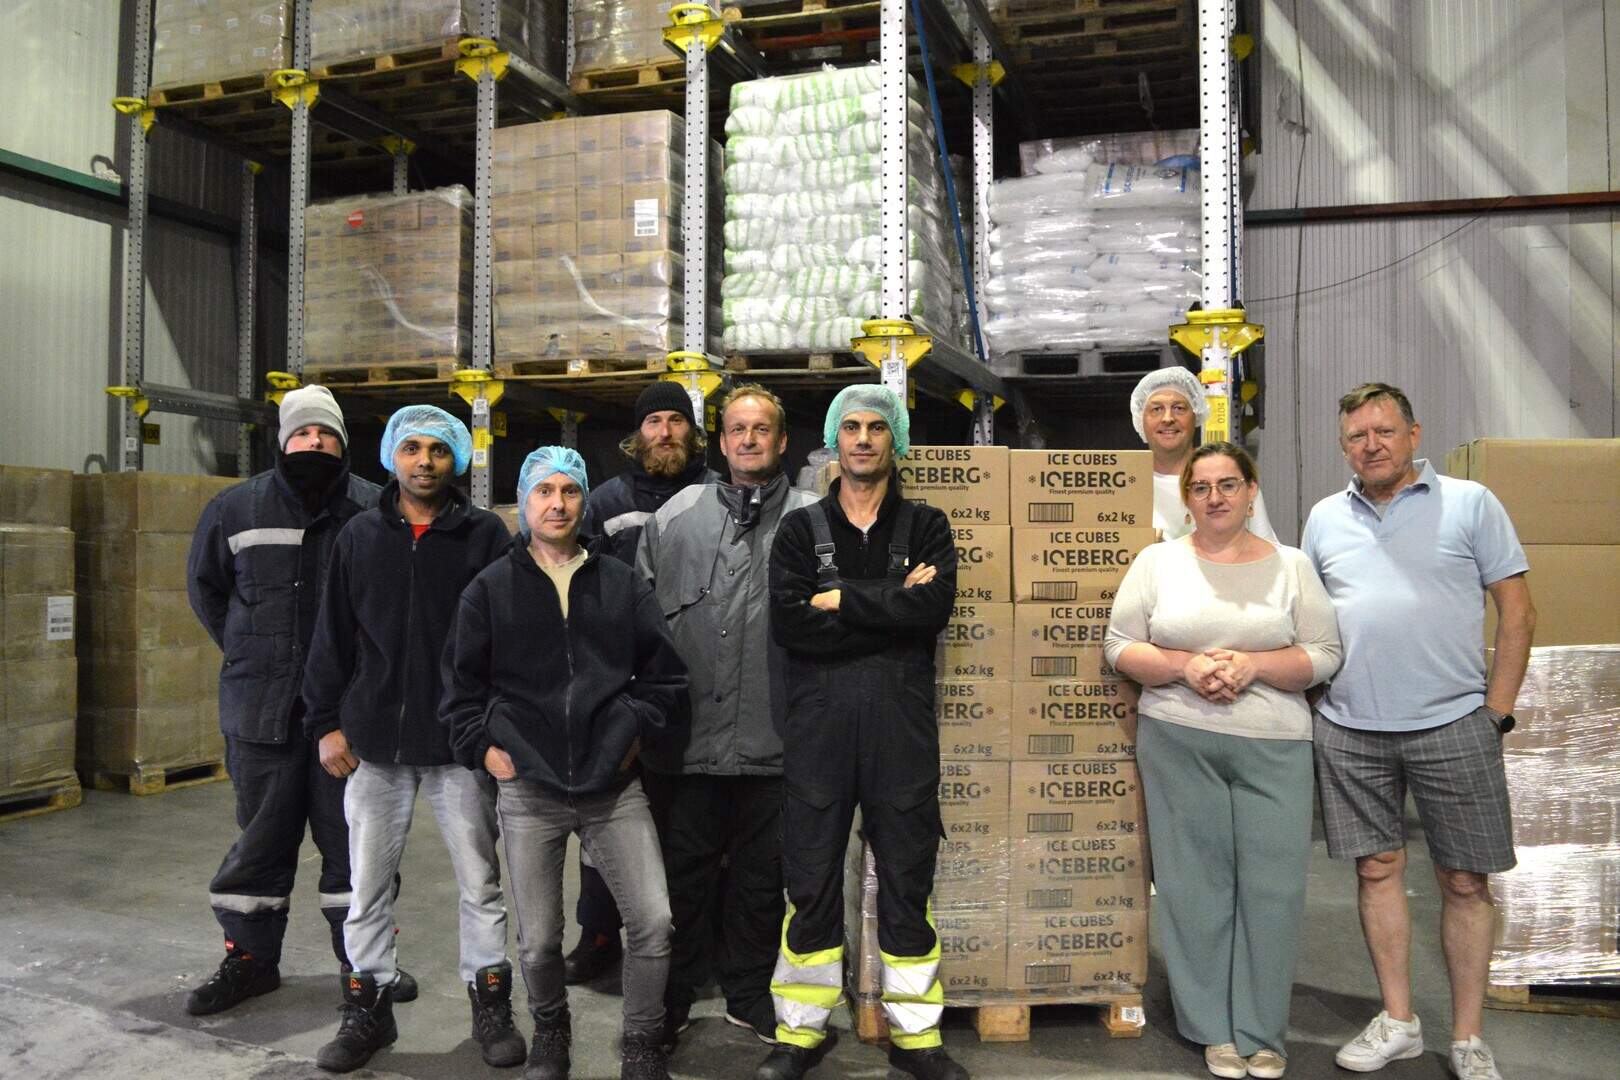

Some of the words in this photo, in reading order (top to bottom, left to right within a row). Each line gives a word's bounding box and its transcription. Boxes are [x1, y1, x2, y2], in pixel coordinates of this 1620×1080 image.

[900, 449, 921, 461] CE
[925, 449, 971, 461] CUBES
[1047, 453, 1069, 465] ICE
[1072, 453, 1118, 466] CUBES
[898, 466, 981, 484] CEBERG
[1040, 471, 1126, 488] ICEBERG
[951, 508, 973, 519] 6x2
[975, 507, 991, 521] kg
[1097, 511, 1118, 523] 6x2
[1121, 511, 1136, 525] kg
[950, 529, 974, 541] BES
[1050, 532, 1072, 544] ICE
[1075, 531, 1120, 544] CUBES
[1043, 549, 1130, 566] ICEBERG
[977, 587, 992, 601] kg
[1100, 590, 1118, 600] 6x
[951, 606, 976, 618] BES
[1051, 607, 1073, 619] ICE
[1076, 607, 1112, 619] CUBE
[1043, 625, 1108, 641] ICEBE
[954, 664, 977, 676] 6x2
[979, 664, 994, 677] kg
[1048, 685, 1070, 697] ICE
[1073, 684, 1118, 697] CUBES
[1041, 702, 1126, 719] ICEBERG
[953, 743, 975, 754] 6x2
[977, 743, 992, 757] kg
[1097, 743, 1118, 754] 6x2
[1120, 742, 1136, 755] kg
[1047, 764, 1069, 776] ICE
[1072, 763, 1117, 775] CUBES
[1040, 780, 1126, 798] ICEBERG
[950, 823, 972, 833] 6x2
[975, 822, 990, 835] kg
[1096, 820, 1117, 831] 6x2
[1120, 820, 1135, 833] kg
[1047, 839, 1069, 852] ICE
[1072, 839, 1116, 851] CUBES
[1039, 856, 1125, 874] ICEBERG
[1095, 896, 1117, 906] 6x2
[1119, 895, 1133, 908] kg
[1045, 915, 1067, 928] ICE
[1070, 914, 1114, 928] CUBES
[1038, 931, 1123, 951] ICEBERG
[949, 976, 971, 986] 6x2
[974, 975, 988, 987] kg
[1093, 970, 1115, 982] 6x2
